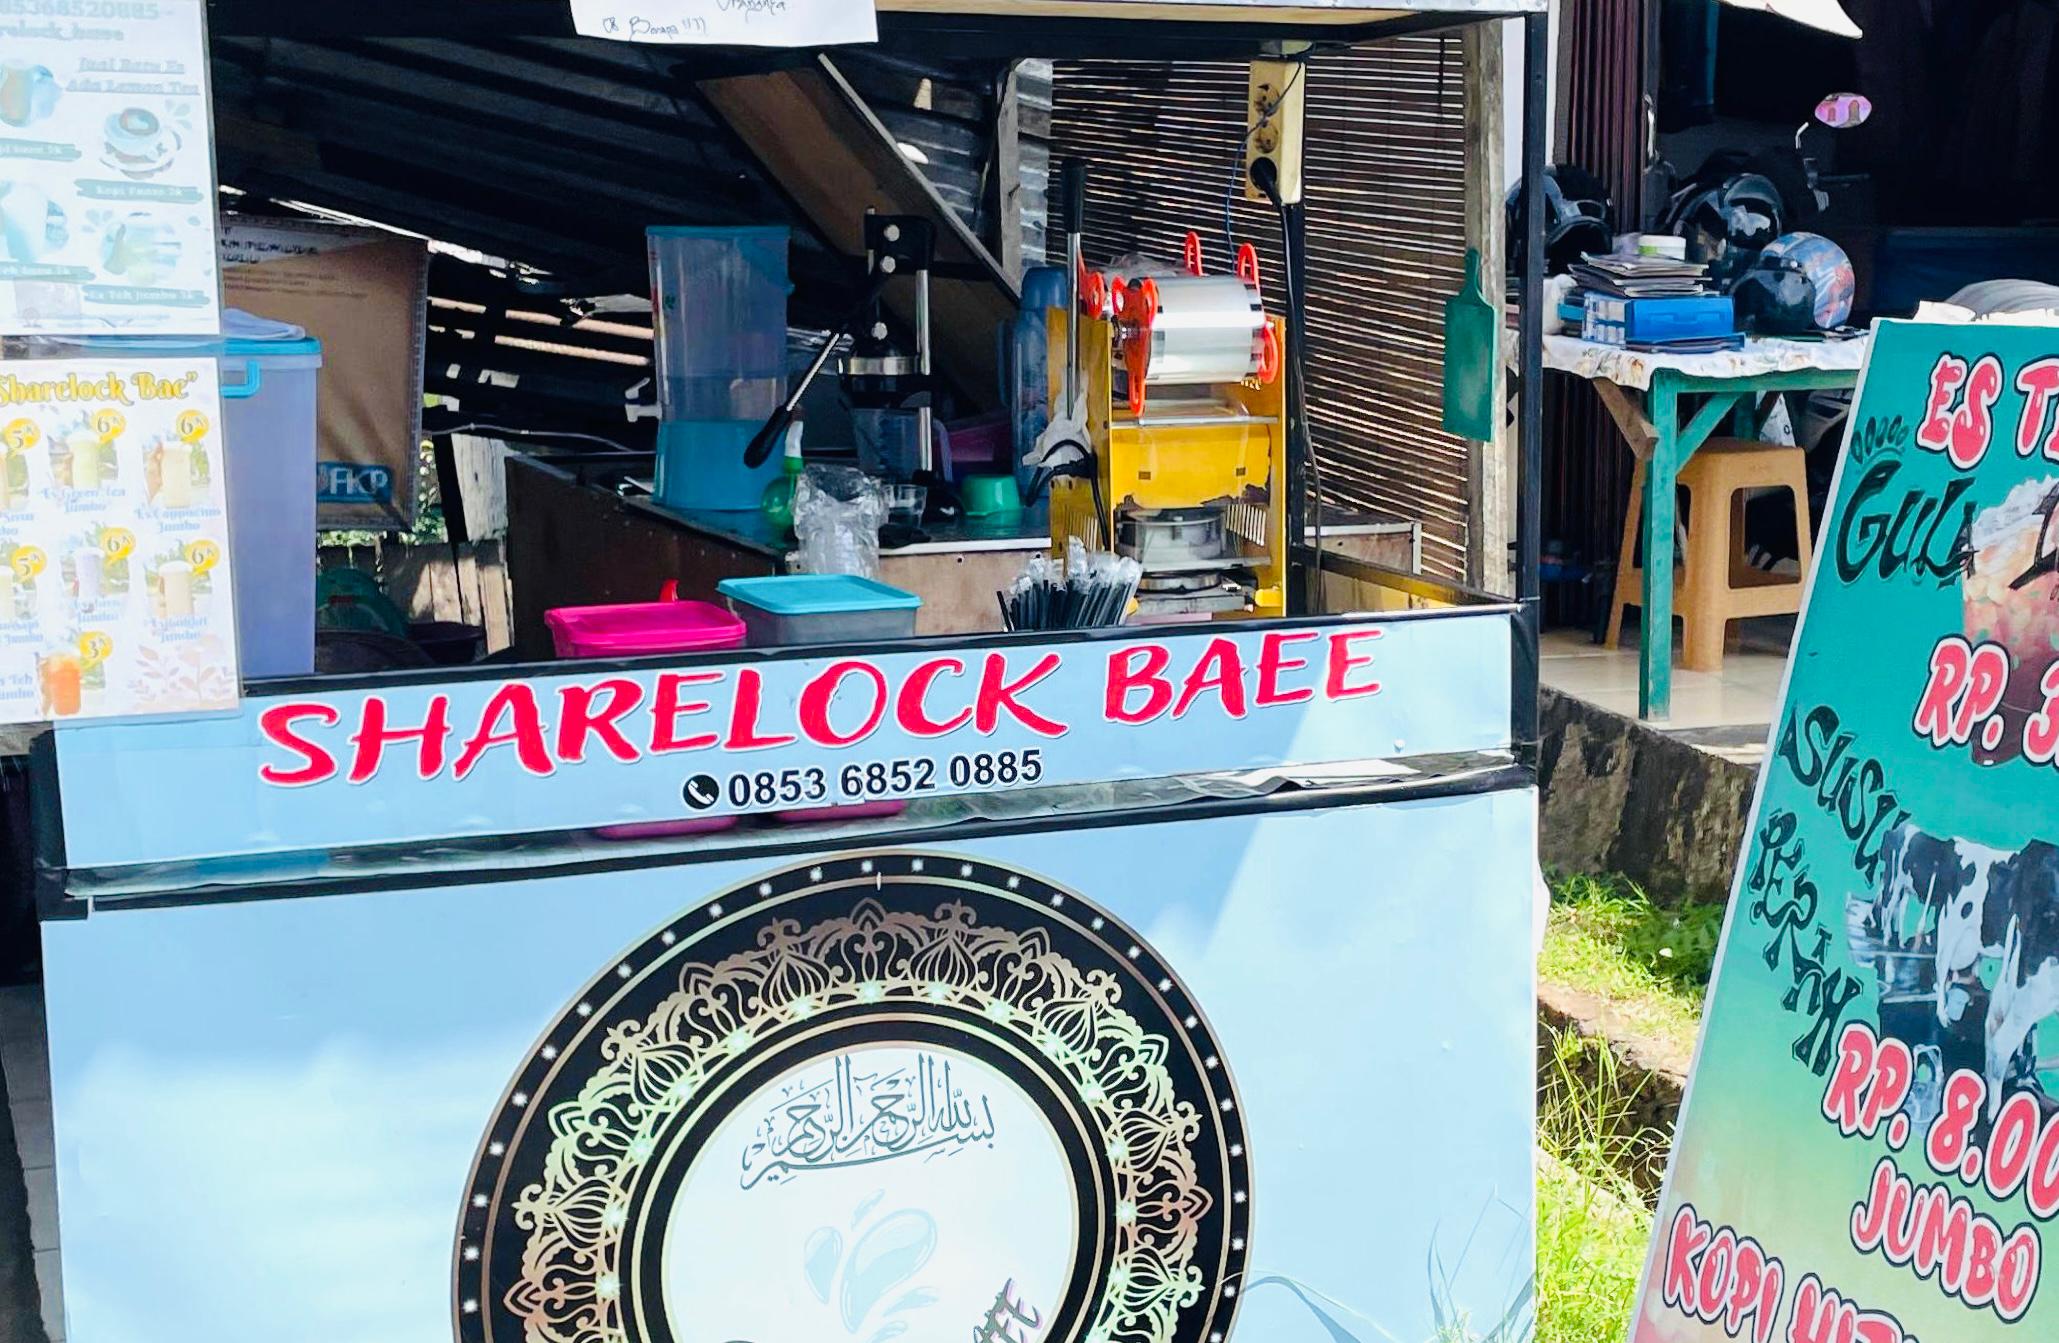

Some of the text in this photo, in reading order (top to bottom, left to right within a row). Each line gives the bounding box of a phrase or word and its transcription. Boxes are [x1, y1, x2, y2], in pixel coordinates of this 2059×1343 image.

[1917, 353, 2003, 470] ES
[259, 629, 1383, 786] SHARELOCK BAEE
[729, 749, 1042, 806] 0853 6852 0885
[1664, 1203, 1784, 1343] KOPI
[1851, 1157, 2041, 1323] JUMBO
